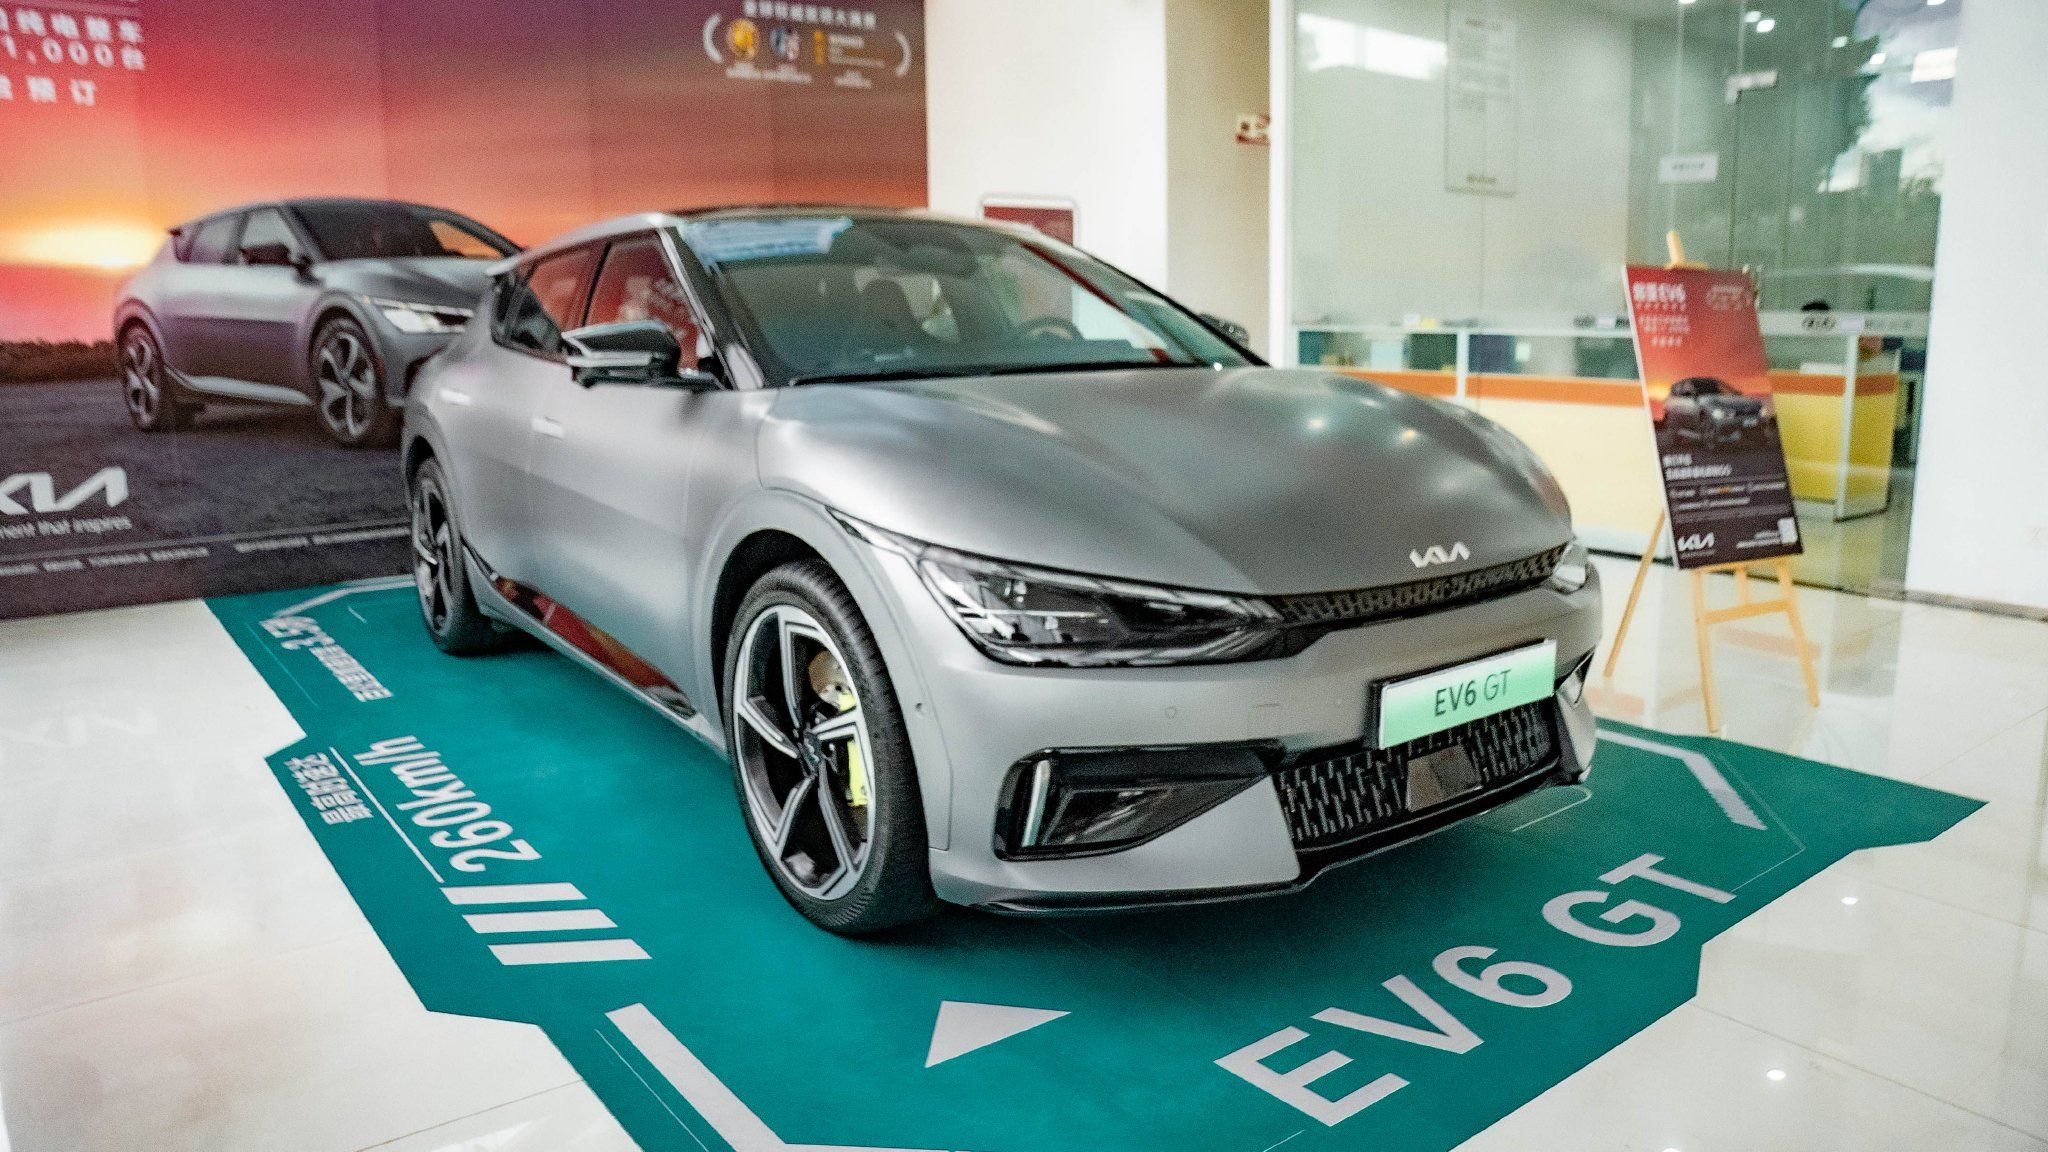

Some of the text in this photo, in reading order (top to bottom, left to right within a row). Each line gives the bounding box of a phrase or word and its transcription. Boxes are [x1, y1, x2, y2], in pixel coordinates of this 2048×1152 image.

[1409, 541, 1471, 568] KIA
[1434, 668, 1513, 718] EV6 GT
[353, 735, 543, 873] 260km/h
[1213, 852, 1738, 1127] EV6 GT
